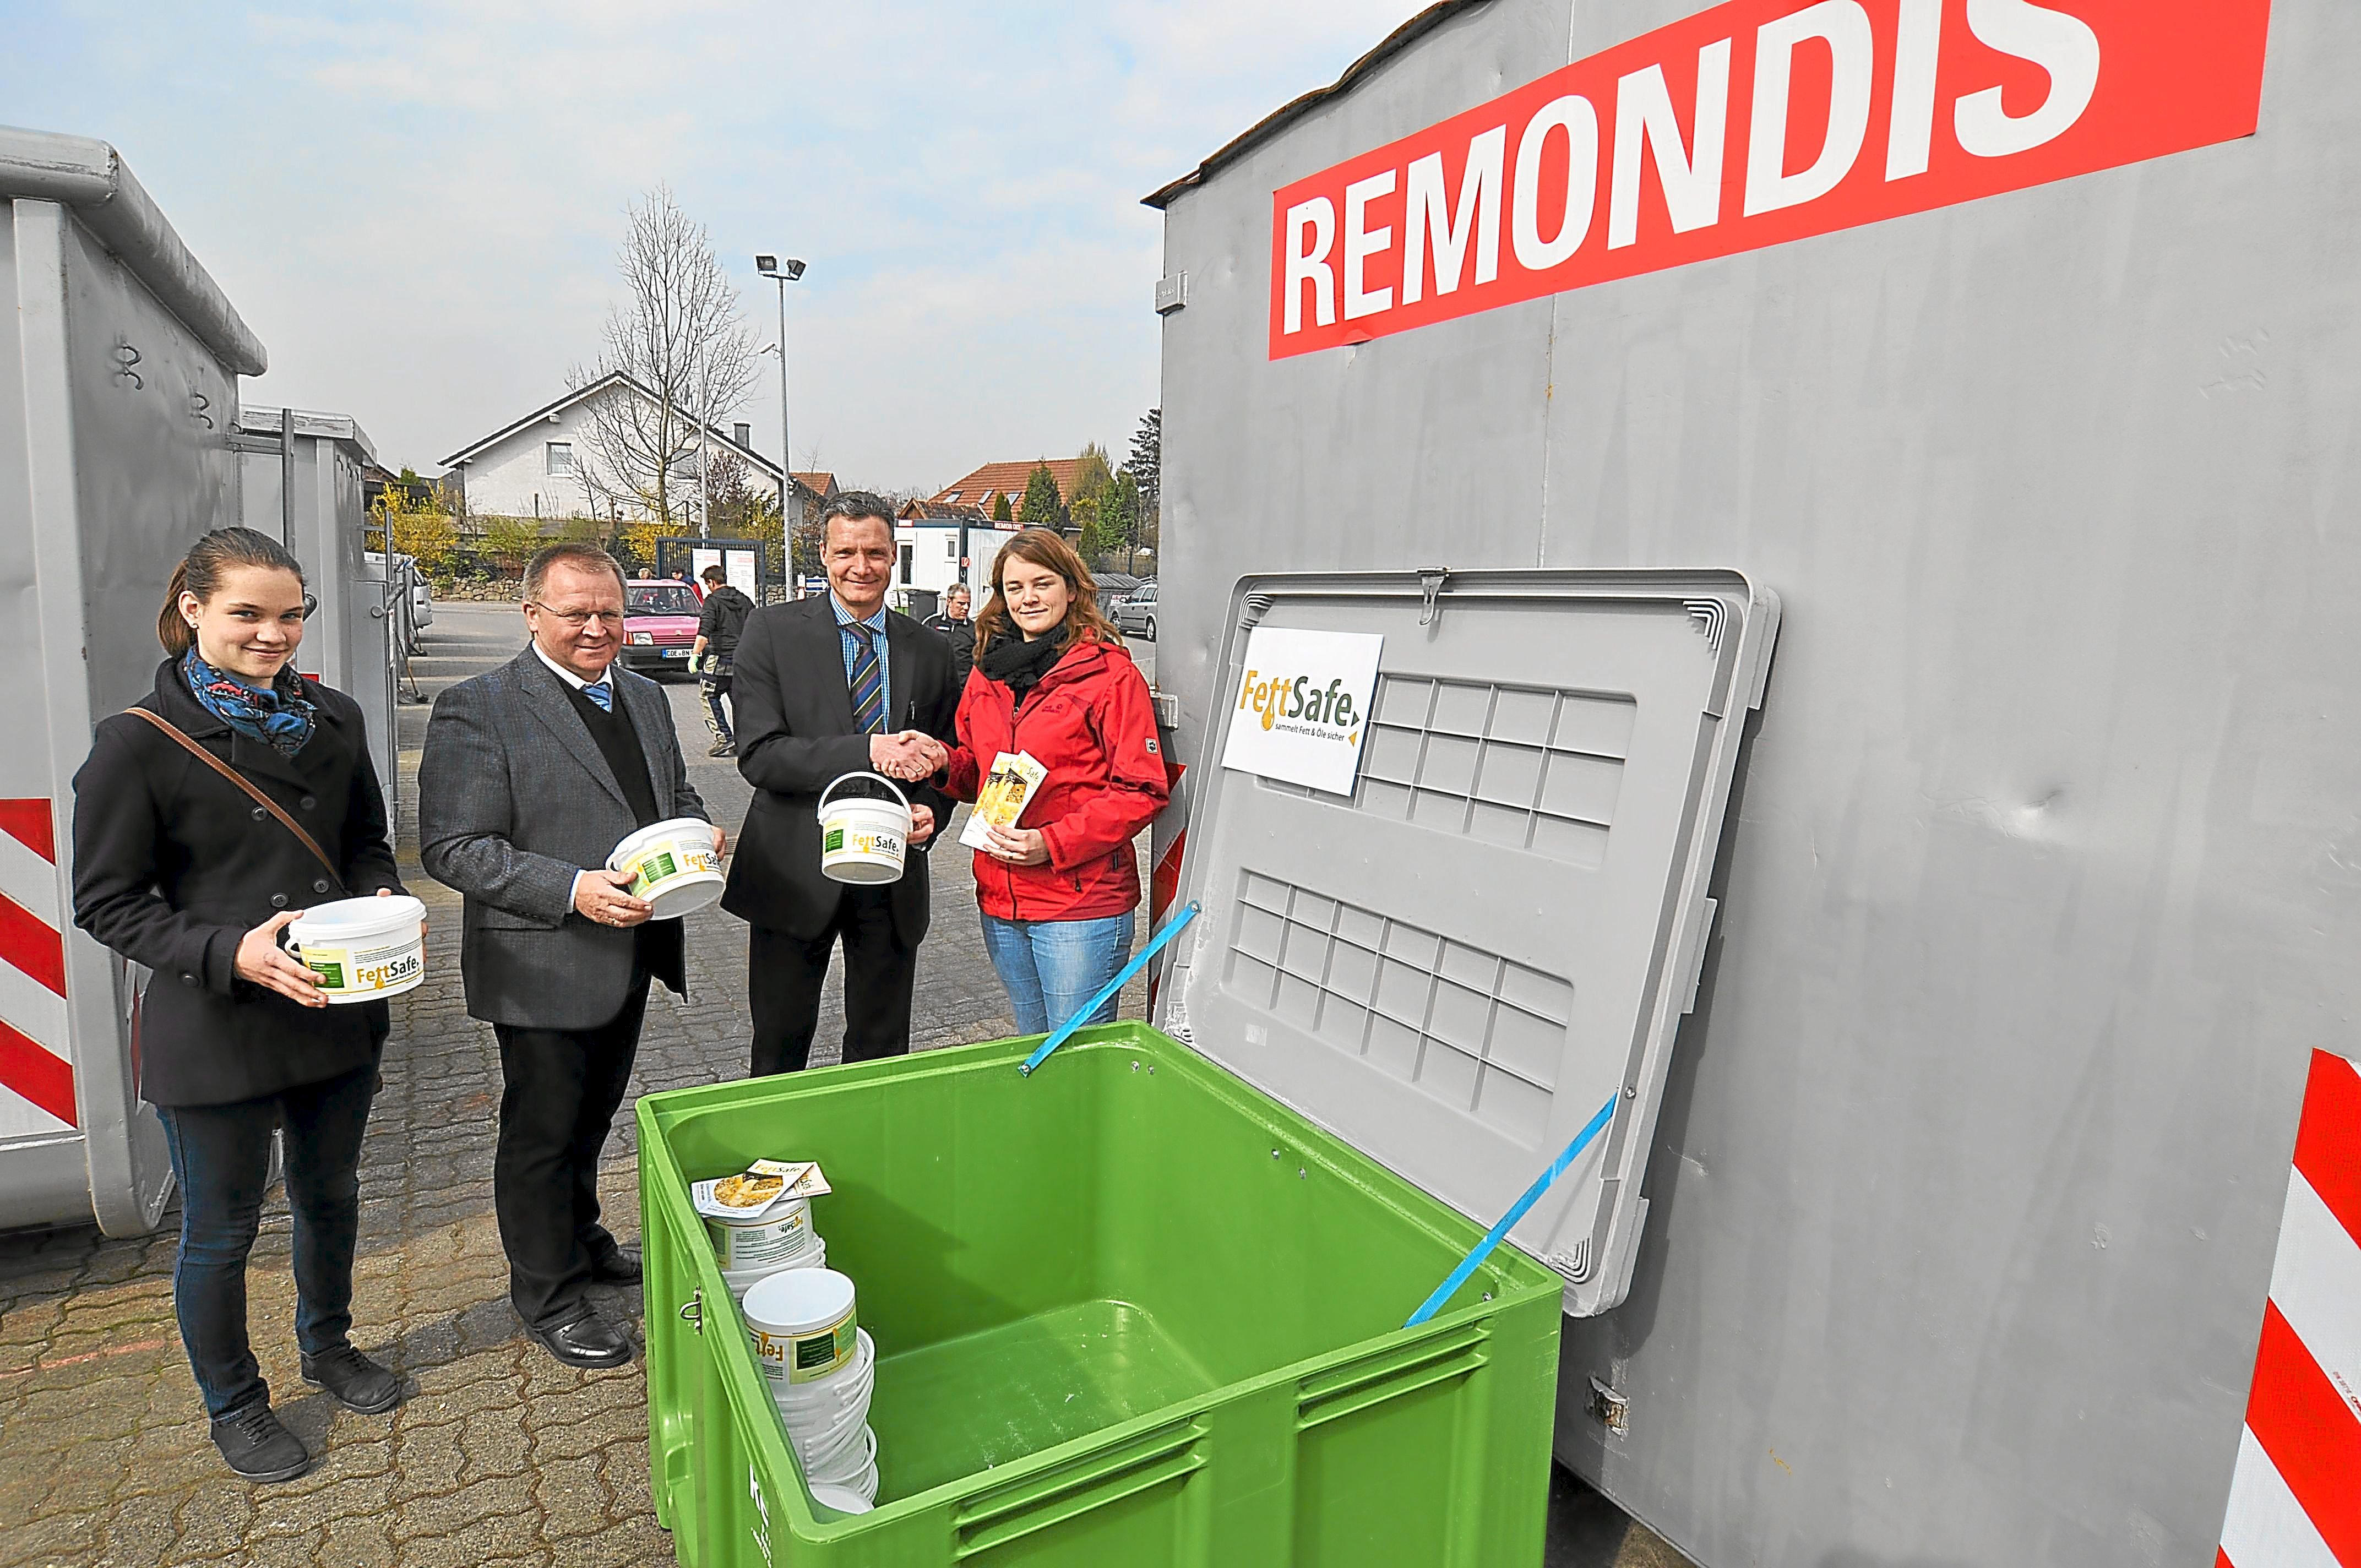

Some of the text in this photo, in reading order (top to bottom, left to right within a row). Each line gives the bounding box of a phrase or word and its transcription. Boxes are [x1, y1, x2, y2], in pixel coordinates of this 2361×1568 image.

[1283, 0, 2101, 335] REMONDIS
[1239, 669, 1352, 731] FettSafe
[1275, 723, 1345, 741] sammelt Fett & Öle sicher
[852, 834, 897, 853] FettSafe
[356, 955, 417, 989] FettSafe
[751, 1331, 783, 1362] Fett
